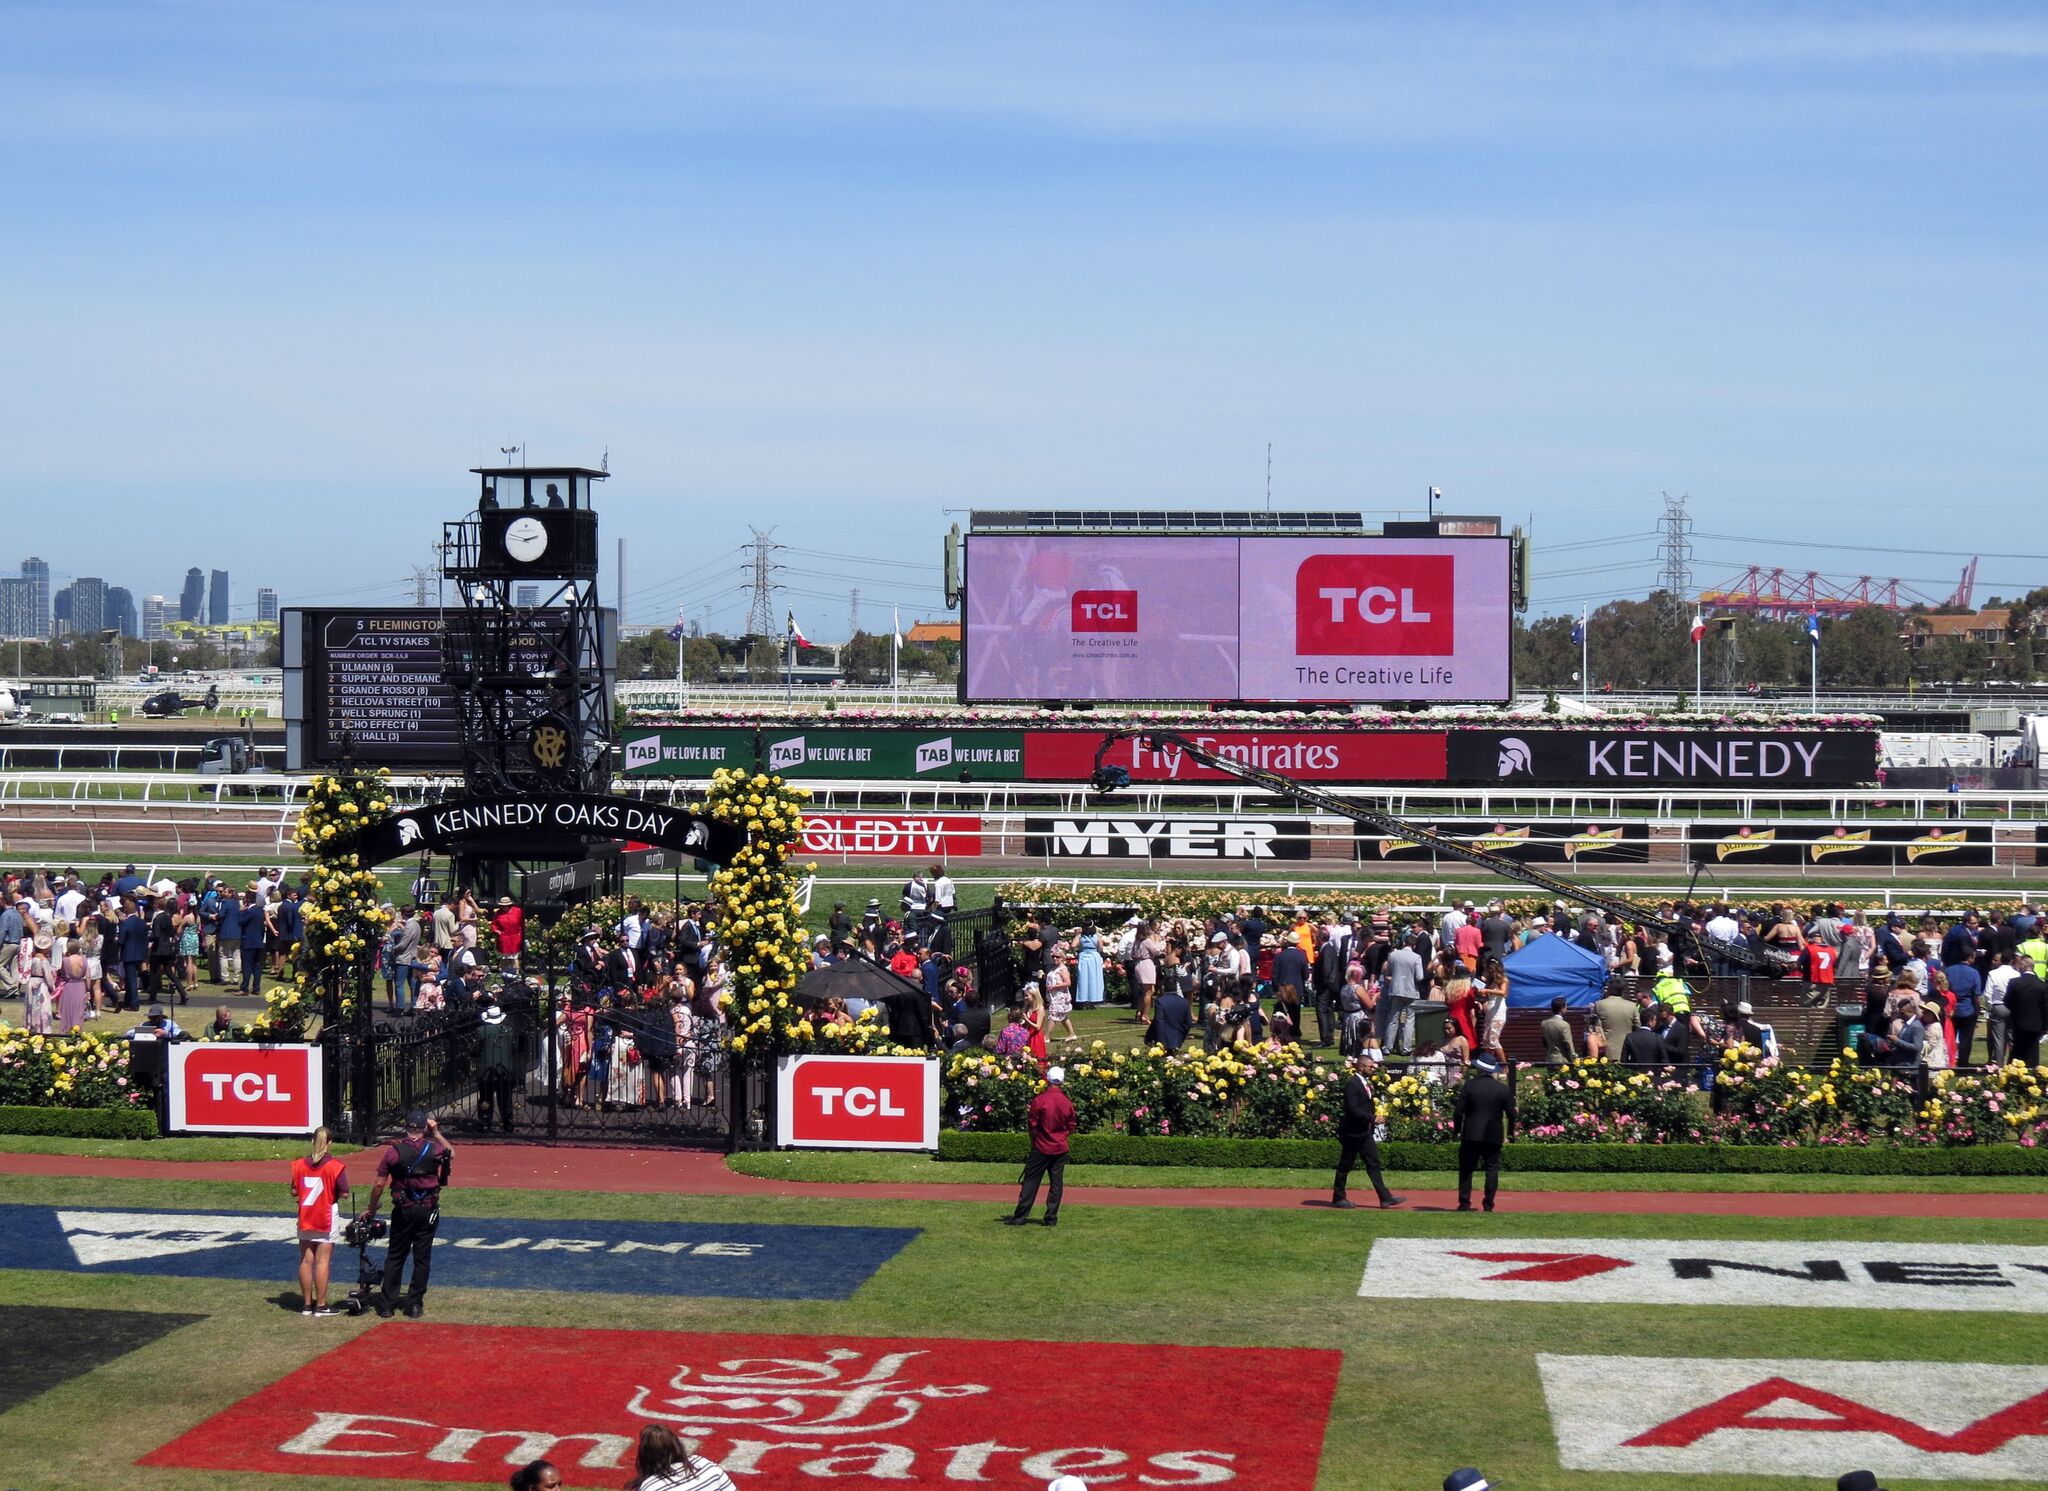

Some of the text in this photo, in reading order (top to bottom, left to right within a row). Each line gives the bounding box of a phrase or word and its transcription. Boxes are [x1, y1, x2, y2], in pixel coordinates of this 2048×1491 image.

[1081, 603, 1128, 619] TCL
[1319, 586, 1431, 624] TCL
[357, 620, 364, 630] 5
[360, 637, 430, 646] TCL TV STAKES
[1072, 638, 1138, 647] The Creative Life
[342, 663, 381, 671] ULMANN
[383, 664, 394, 673] (5)
[1296, 667, 1453, 684] The Creative Life
[341, 675, 378, 683] SUPPLY
[380, 675, 400, 683] AND
[341, 686, 380, 694] GRANDE
[382, 687, 415, 695] ROSSO
[417, 687, 428, 696] (8)
[342, 698, 384, 706] HELLOVA
[386, 698, 422, 706] STREET
[425, 698, 441, 707] (10)
[329, 709, 421, 719] 7 WELL SPRUNG (1)
[342, 721, 368, 729] ECHO
[370, 721, 405, 729] EFFECT
[407, 721, 418, 730] (4)
[362, 732, 386, 740] HALL
[388, 732, 399, 741] (3)
[629, 746, 725, 760] TAB WE LOVE A BET
[773, 748, 871, 761] TAB WE LOVE A BET
[920, 749, 1020, 762] TAB WE LOVE A BET
[1132, 736, 1183, 777] Fly
[1588, 740, 1823, 778] KENNEDY
[434, 804, 673, 836] KENNEDY OAKS DAY
[803, 819, 944, 852] QLED TV
[1053, 821, 1277, 857] MYER
[645, 850, 665, 869] no entry
[549, 866, 576, 892] entry only
[1817, 952, 1831, 969] 7
[202, 1072, 291, 1102] TCL
[812, 1087, 905, 1117] TCL
[302, 1176, 325, 1206] 7
